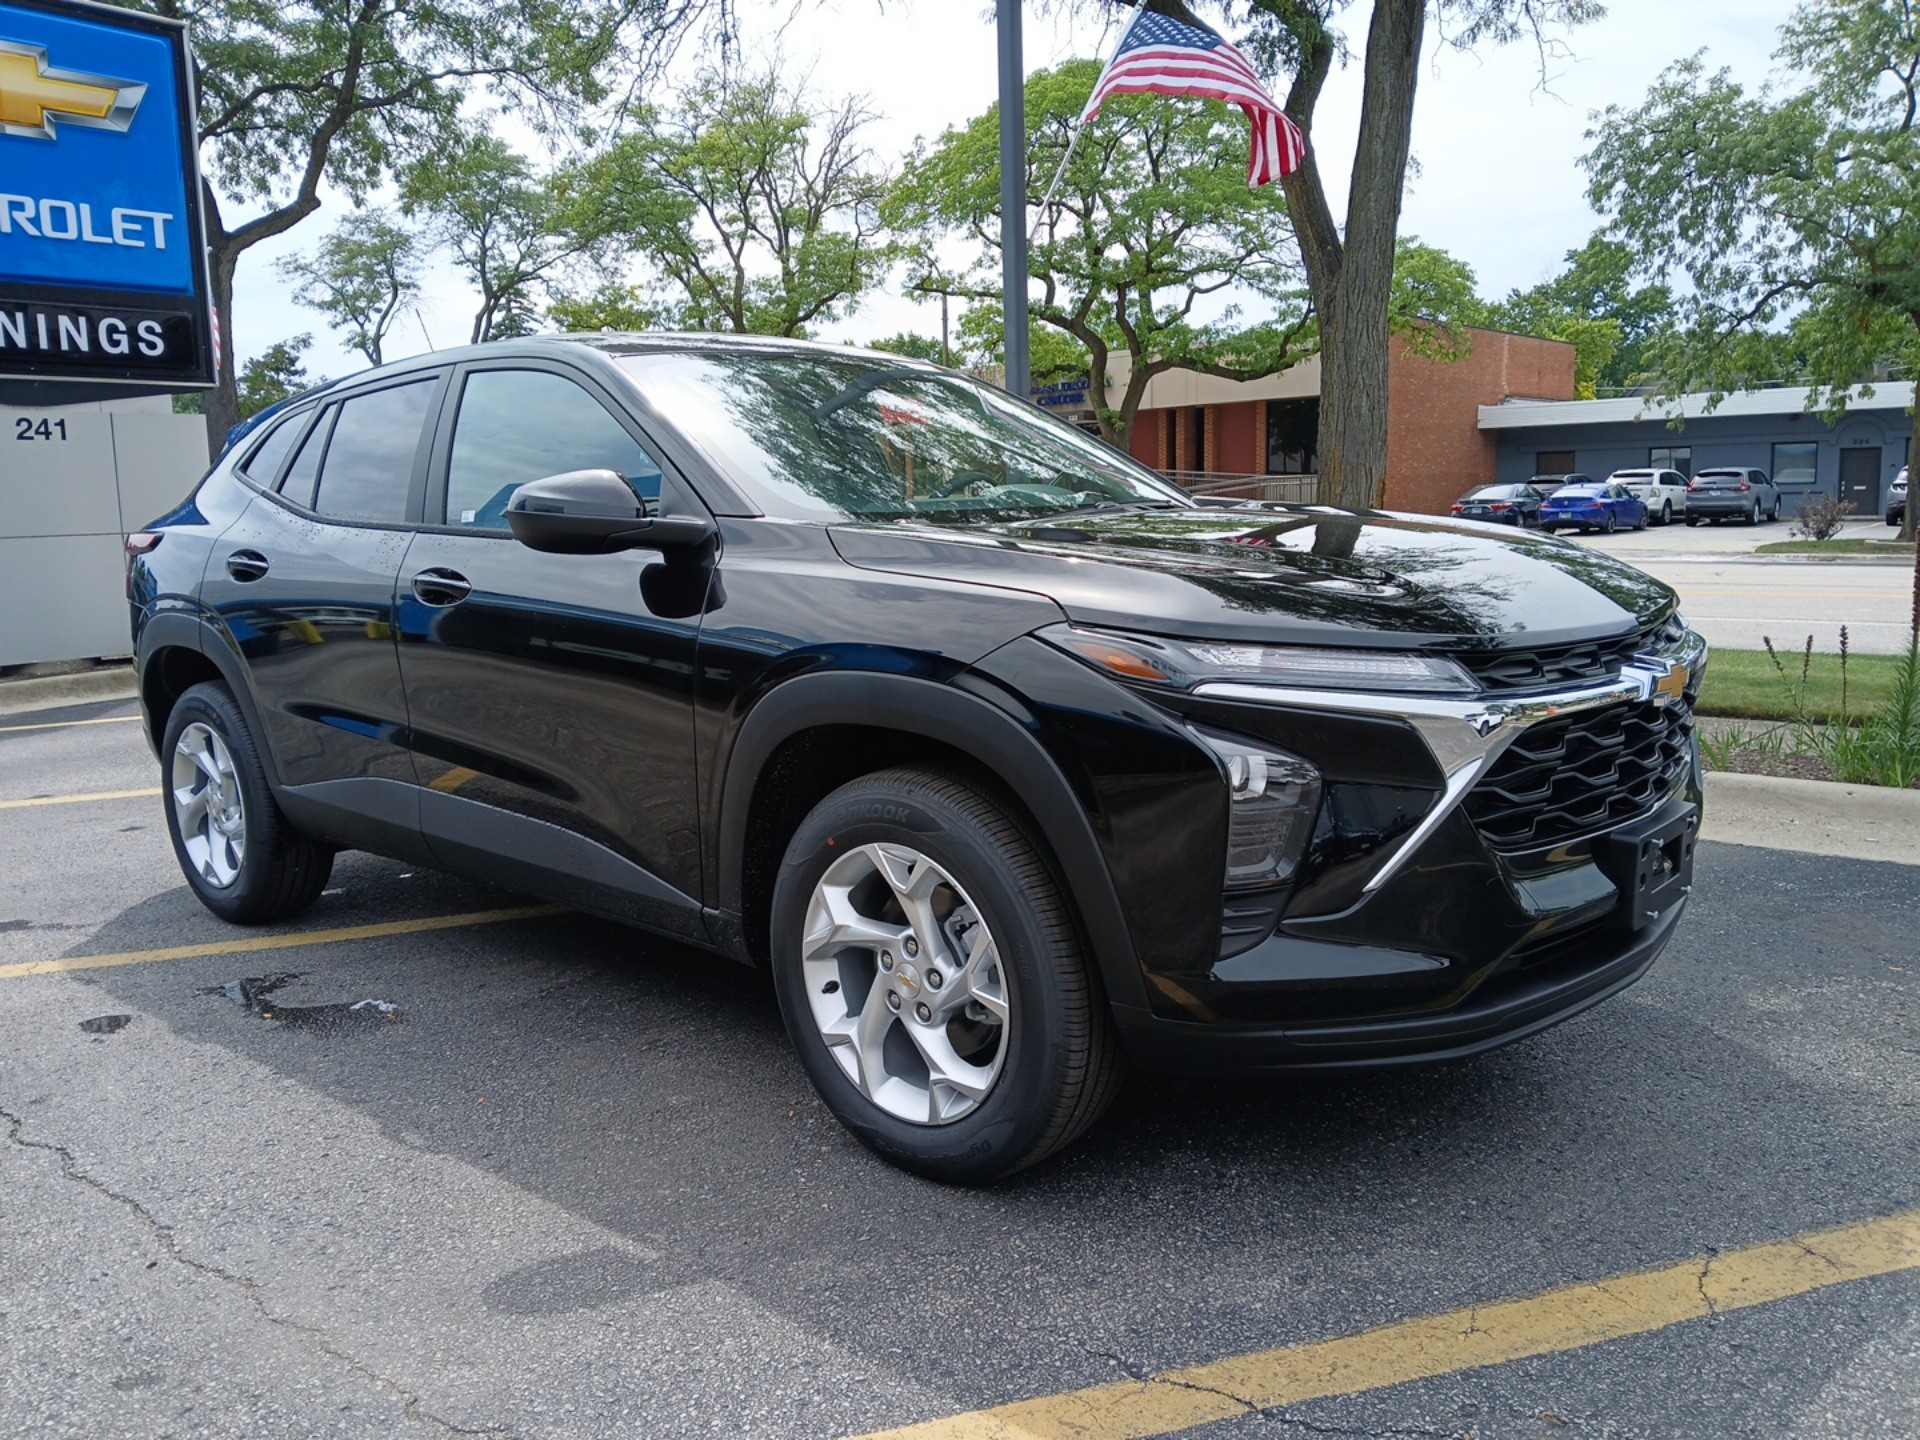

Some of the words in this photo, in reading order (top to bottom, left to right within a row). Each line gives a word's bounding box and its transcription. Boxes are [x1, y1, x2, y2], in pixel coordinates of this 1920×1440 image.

[0, 193, 173, 249] ROLET
[0, 310, 165, 357] NINGS
[16, 417, 67, 441] 241
